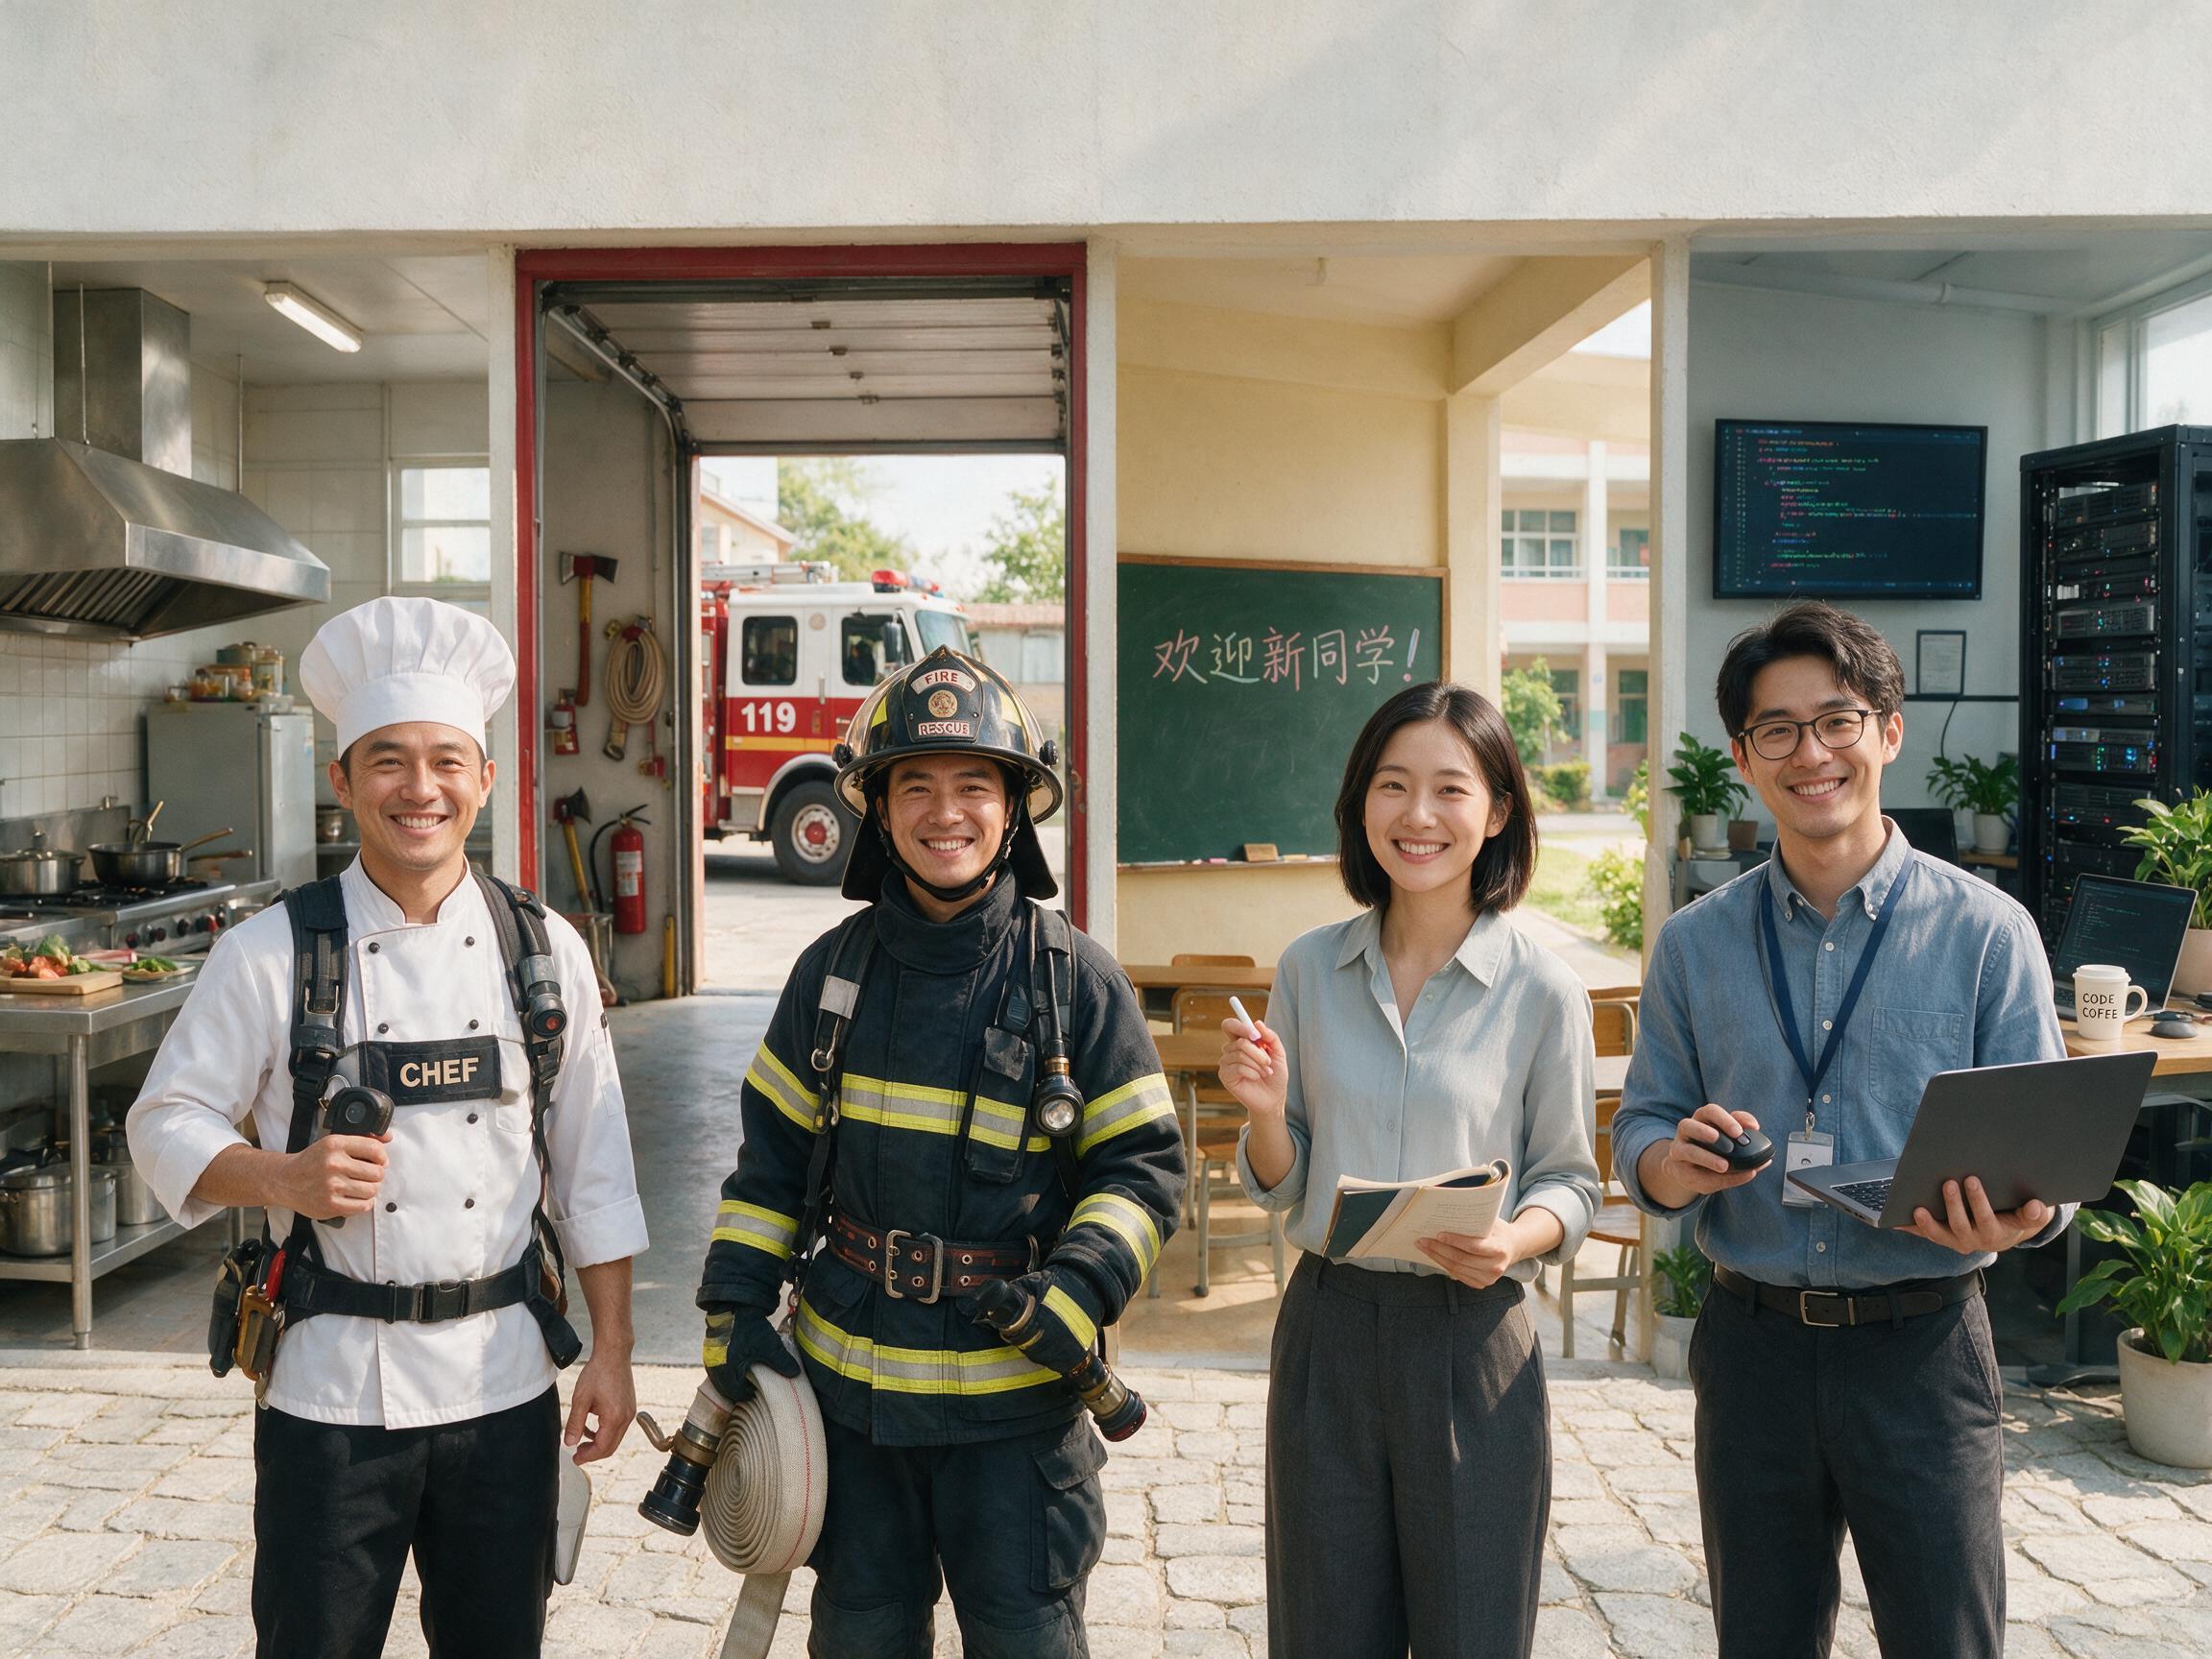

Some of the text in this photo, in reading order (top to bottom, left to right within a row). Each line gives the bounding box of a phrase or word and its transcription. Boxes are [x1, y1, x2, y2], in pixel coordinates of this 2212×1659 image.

[1153, 625, 1420, 691] 欢迎新同学!
[924, 671, 959, 685] FIRE
[740, 701, 797, 733] 119
[919, 722, 969, 736] RESCUE
[2082, 993, 2115, 1005] CODE
[2082, 1007, 2118, 1020] COFEE
[399, 1057, 479, 1088] CHEF
